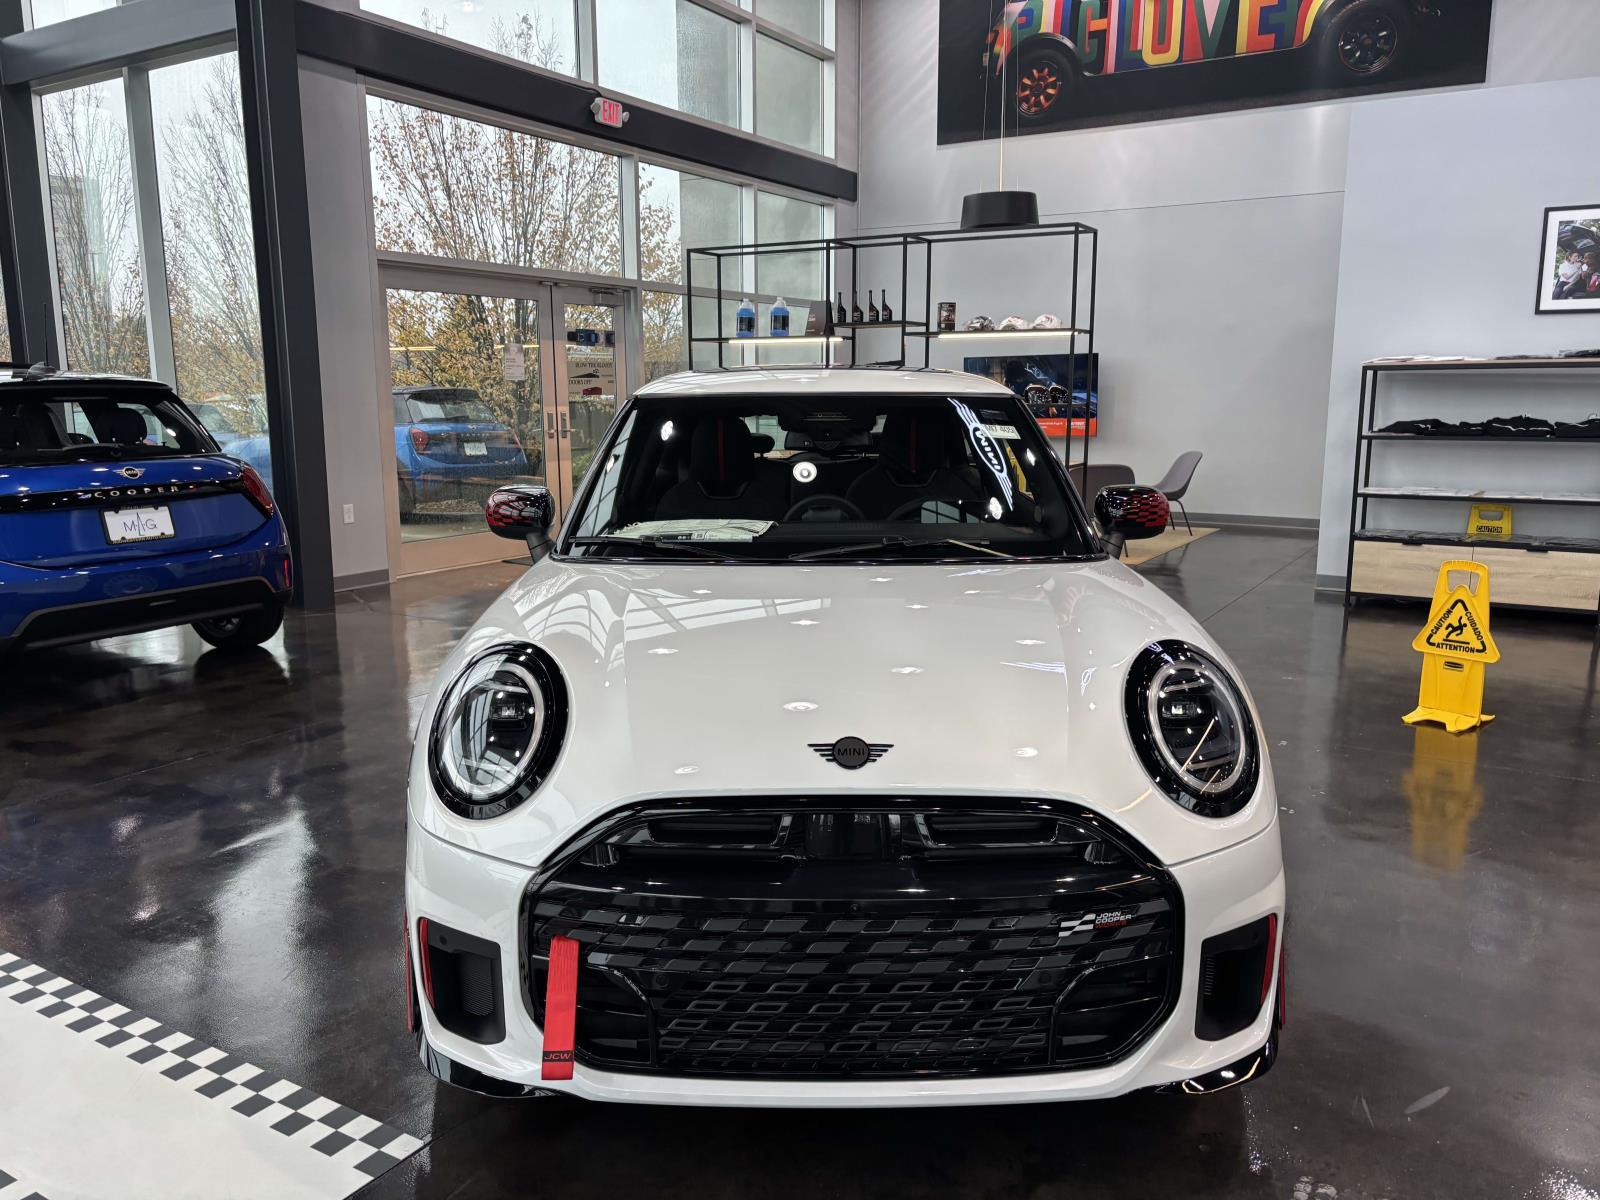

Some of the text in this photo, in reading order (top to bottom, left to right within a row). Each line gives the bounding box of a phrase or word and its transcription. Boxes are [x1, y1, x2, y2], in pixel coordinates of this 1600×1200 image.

[602, 98, 620, 126] EXIT
[94, 486, 178, 498] COOPER
[1477, 525, 1503, 533] CAUTION
[1431, 608, 1484, 641] CAUTION CUIDADO
[1435, 641, 1476, 654] ATTENTION
[838, 748, 865, 756] MINI
[1095, 914, 1132, 924] COOPER
[1096, 911, 1121, 919] JOHN
